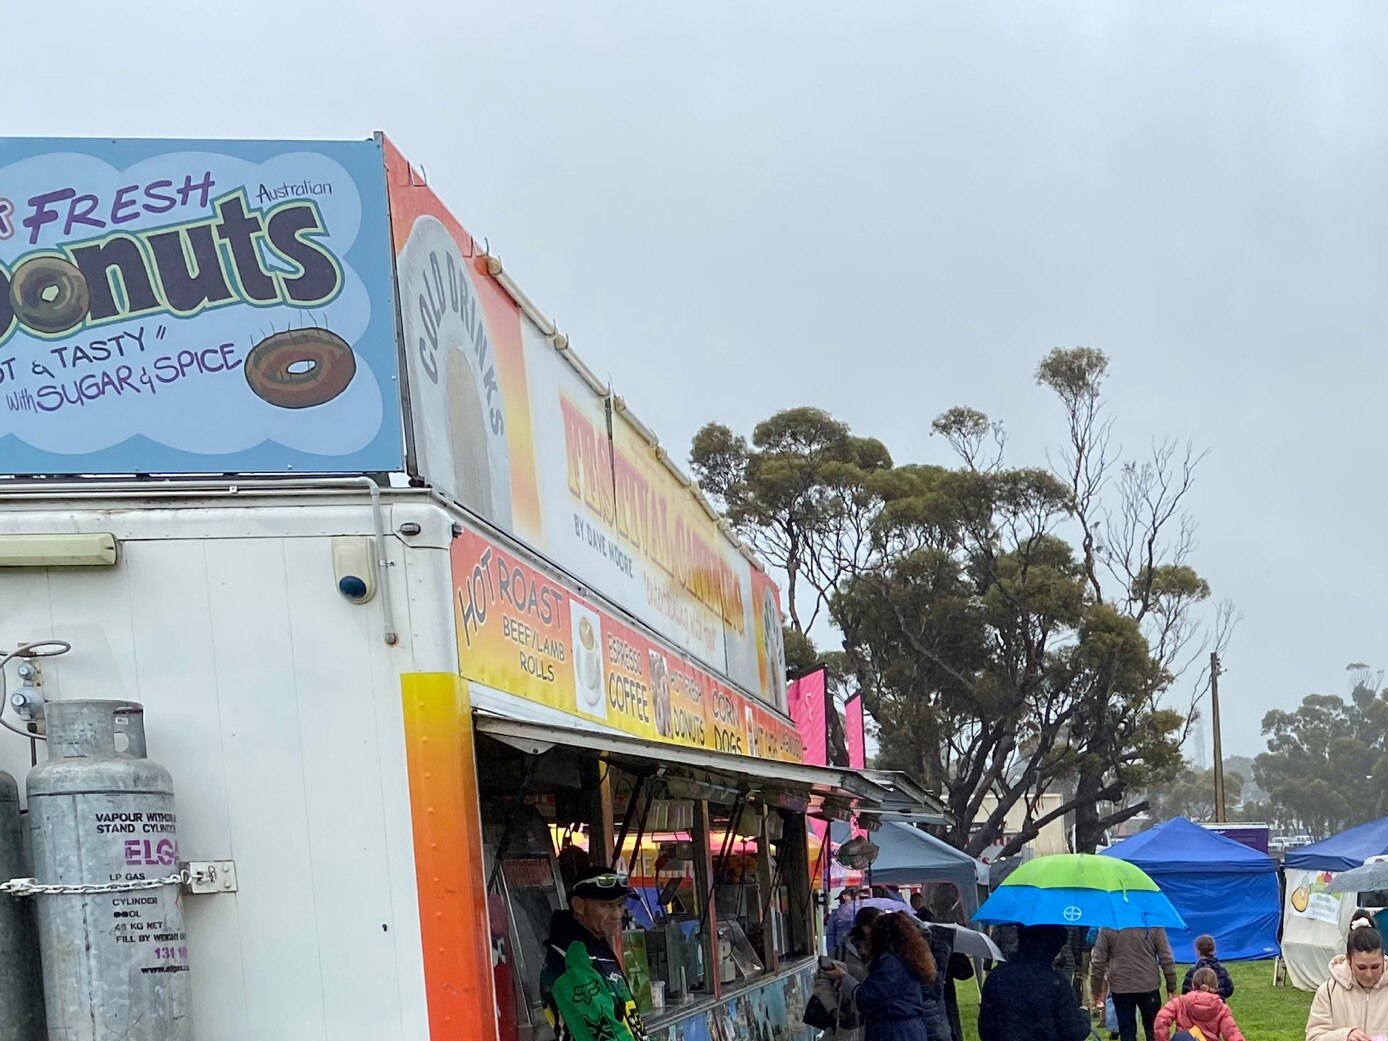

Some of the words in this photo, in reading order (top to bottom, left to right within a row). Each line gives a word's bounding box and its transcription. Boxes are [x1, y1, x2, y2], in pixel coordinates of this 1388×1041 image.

[256, 180, 333, 203] Australian
[23, 171, 215, 244] FRESH
[419, 250, 446, 385] COLD
[445, 249, 504, 436] DRINKS
[6, 388, 38, 413] with
[36, 365, 141, 411] SUGAR
[154, 343, 243, 383] SPICE
[31, 360, 55, 378] &
[587, 525, 608, 557] DAVE
[458, 546, 495, 649] HOT
[497, 555, 564, 630] ROAST
[502, 615, 566, 661] BEEF/LAMB
[519, 651, 555, 682] ROLLS
[608, 672, 649, 723] COFFEE
[712, 689, 740, 729] CORN
[714, 724, 742, 754] DOGS
[95, 813, 143, 822] VAPOUR
[97, 824, 135, 833] STAND
[109, 873, 122, 881] LP
[125, 873, 145, 881] GAS
[112, 897, 158, 906] CYLINDER
[116, 935, 136, 943] FILL
[138, 934, 150, 942] BY
[130, 922, 143, 930] KG
[147, 922, 163, 930] NET
[155, 946, 175, 959] 131
